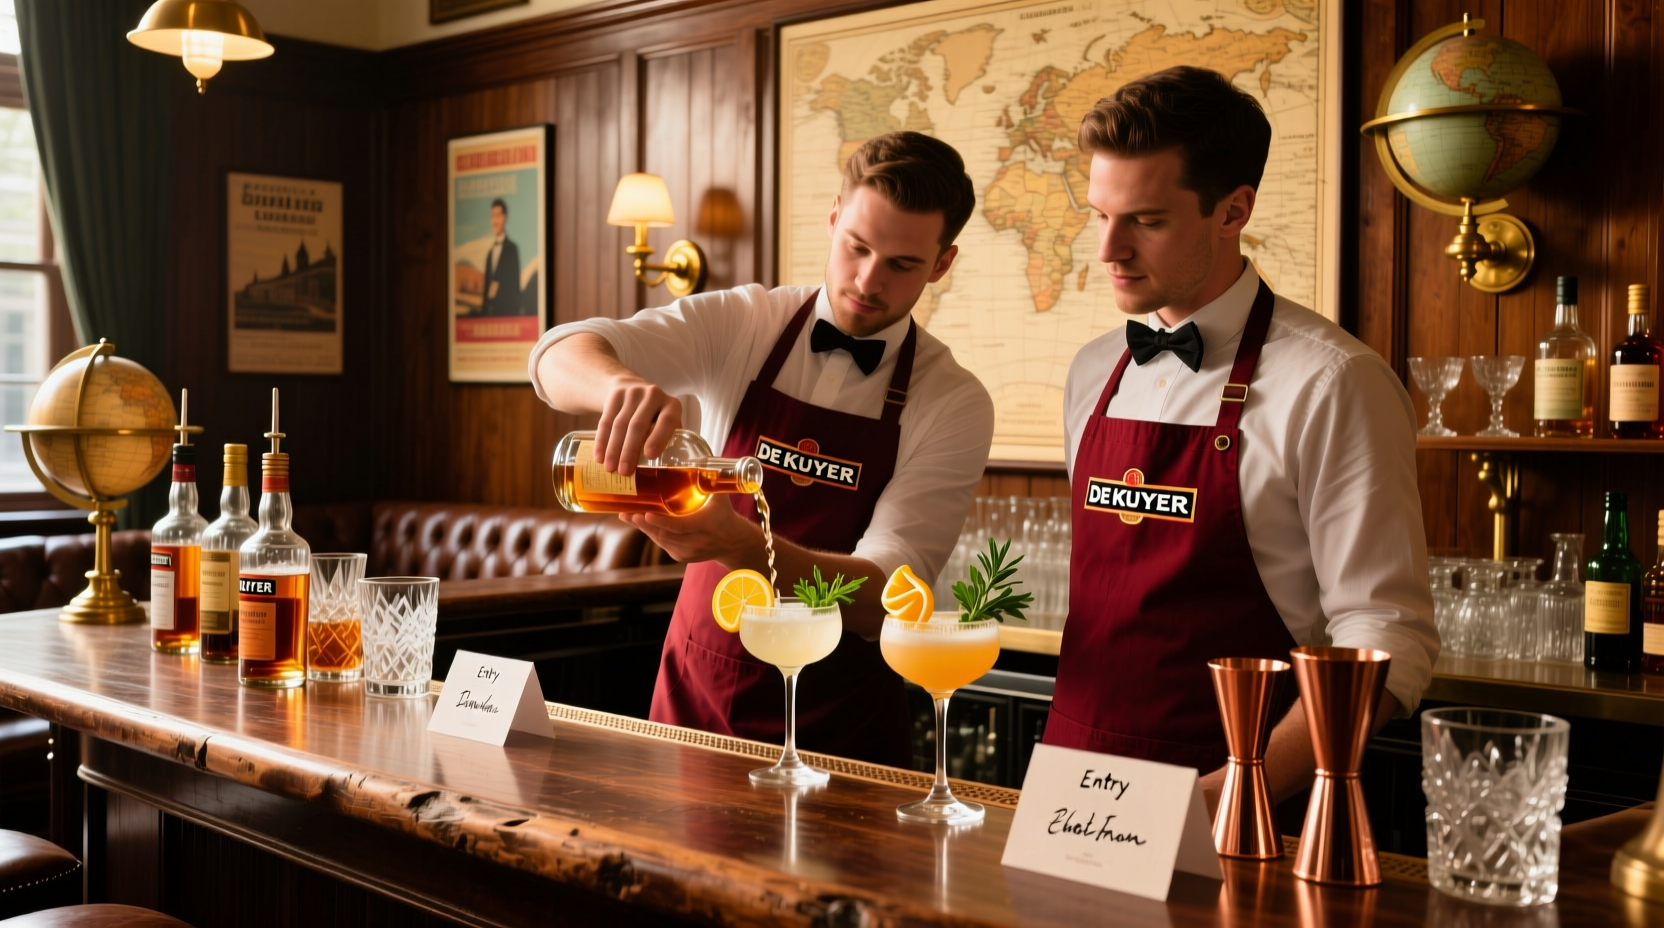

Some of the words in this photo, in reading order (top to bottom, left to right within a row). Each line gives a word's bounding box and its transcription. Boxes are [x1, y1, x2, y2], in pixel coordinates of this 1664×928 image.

[757, 442, 782, 465] DE
[783, 451, 854, 484] KUYER
[1088, 484, 1112, 505] DE
[1112, 487, 1189, 515] KUYER
[1080, 769, 1130, 801] Entry
